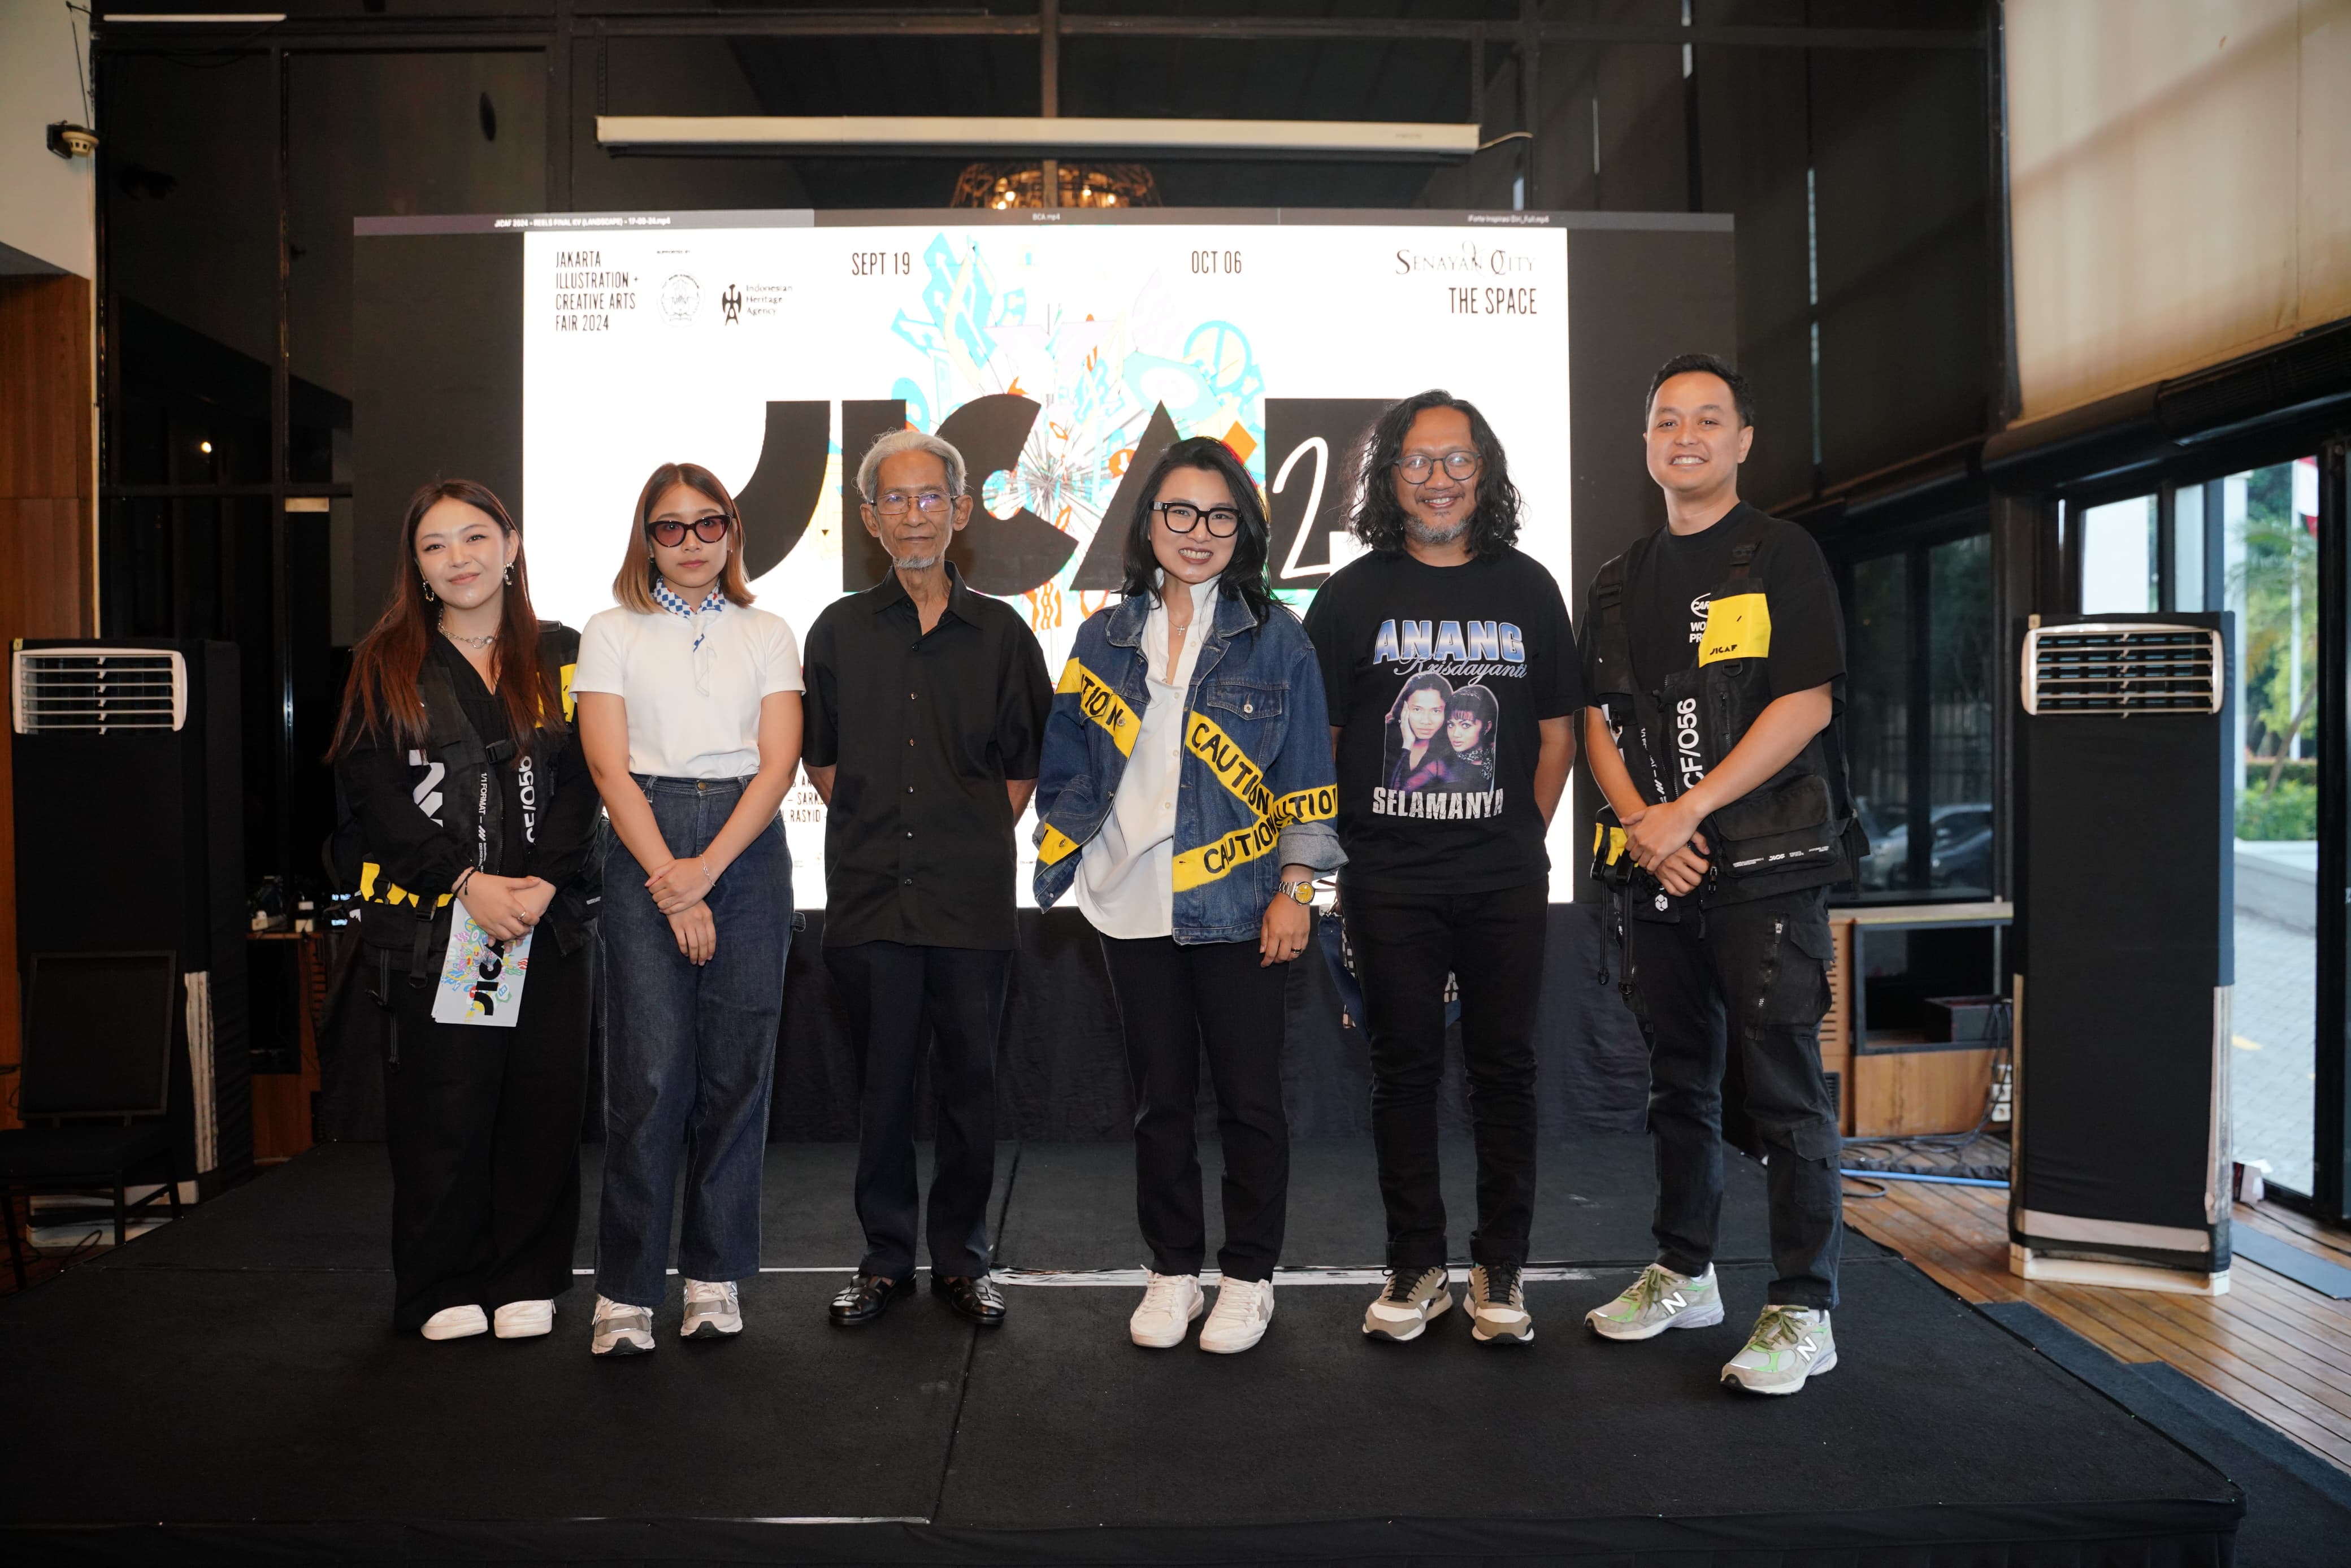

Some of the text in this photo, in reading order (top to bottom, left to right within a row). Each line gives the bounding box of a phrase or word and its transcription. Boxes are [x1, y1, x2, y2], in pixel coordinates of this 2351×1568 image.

[556, 250, 601, 268] JAKARTA
[852, 252, 911, 275] SEPT 19
[1191, 251, 1242, 273] OCT 06
[556, 272, 629, 289] ILLUSTRATION
[746, 284, 793, 292] Indonesian
[556, 293, 636, 310] CREATIVE ARTS
[746, 295, 783, 303] Heritage
[1448, 287, 1537, 314] THE SPACE
[746, 306, 778, 316] Agency
[556, 314, 609, 332] FAIR 2024
[733, 393, 1404, 596] JICF
[1373, 619, 1525, 665] ANANG
[1710, 644, 1738, 655] JICAF
[1081, 674, 1124, 731] TION
[1191, 723, 1270, 815] CAUTION
[478, 783, 488, 815] FORMAT
[1373, 786, 1504, 820] SELAMANYA
[791, 809, 821, 823] RASYID
[1204, 816, 1277, 874] CAUTION
